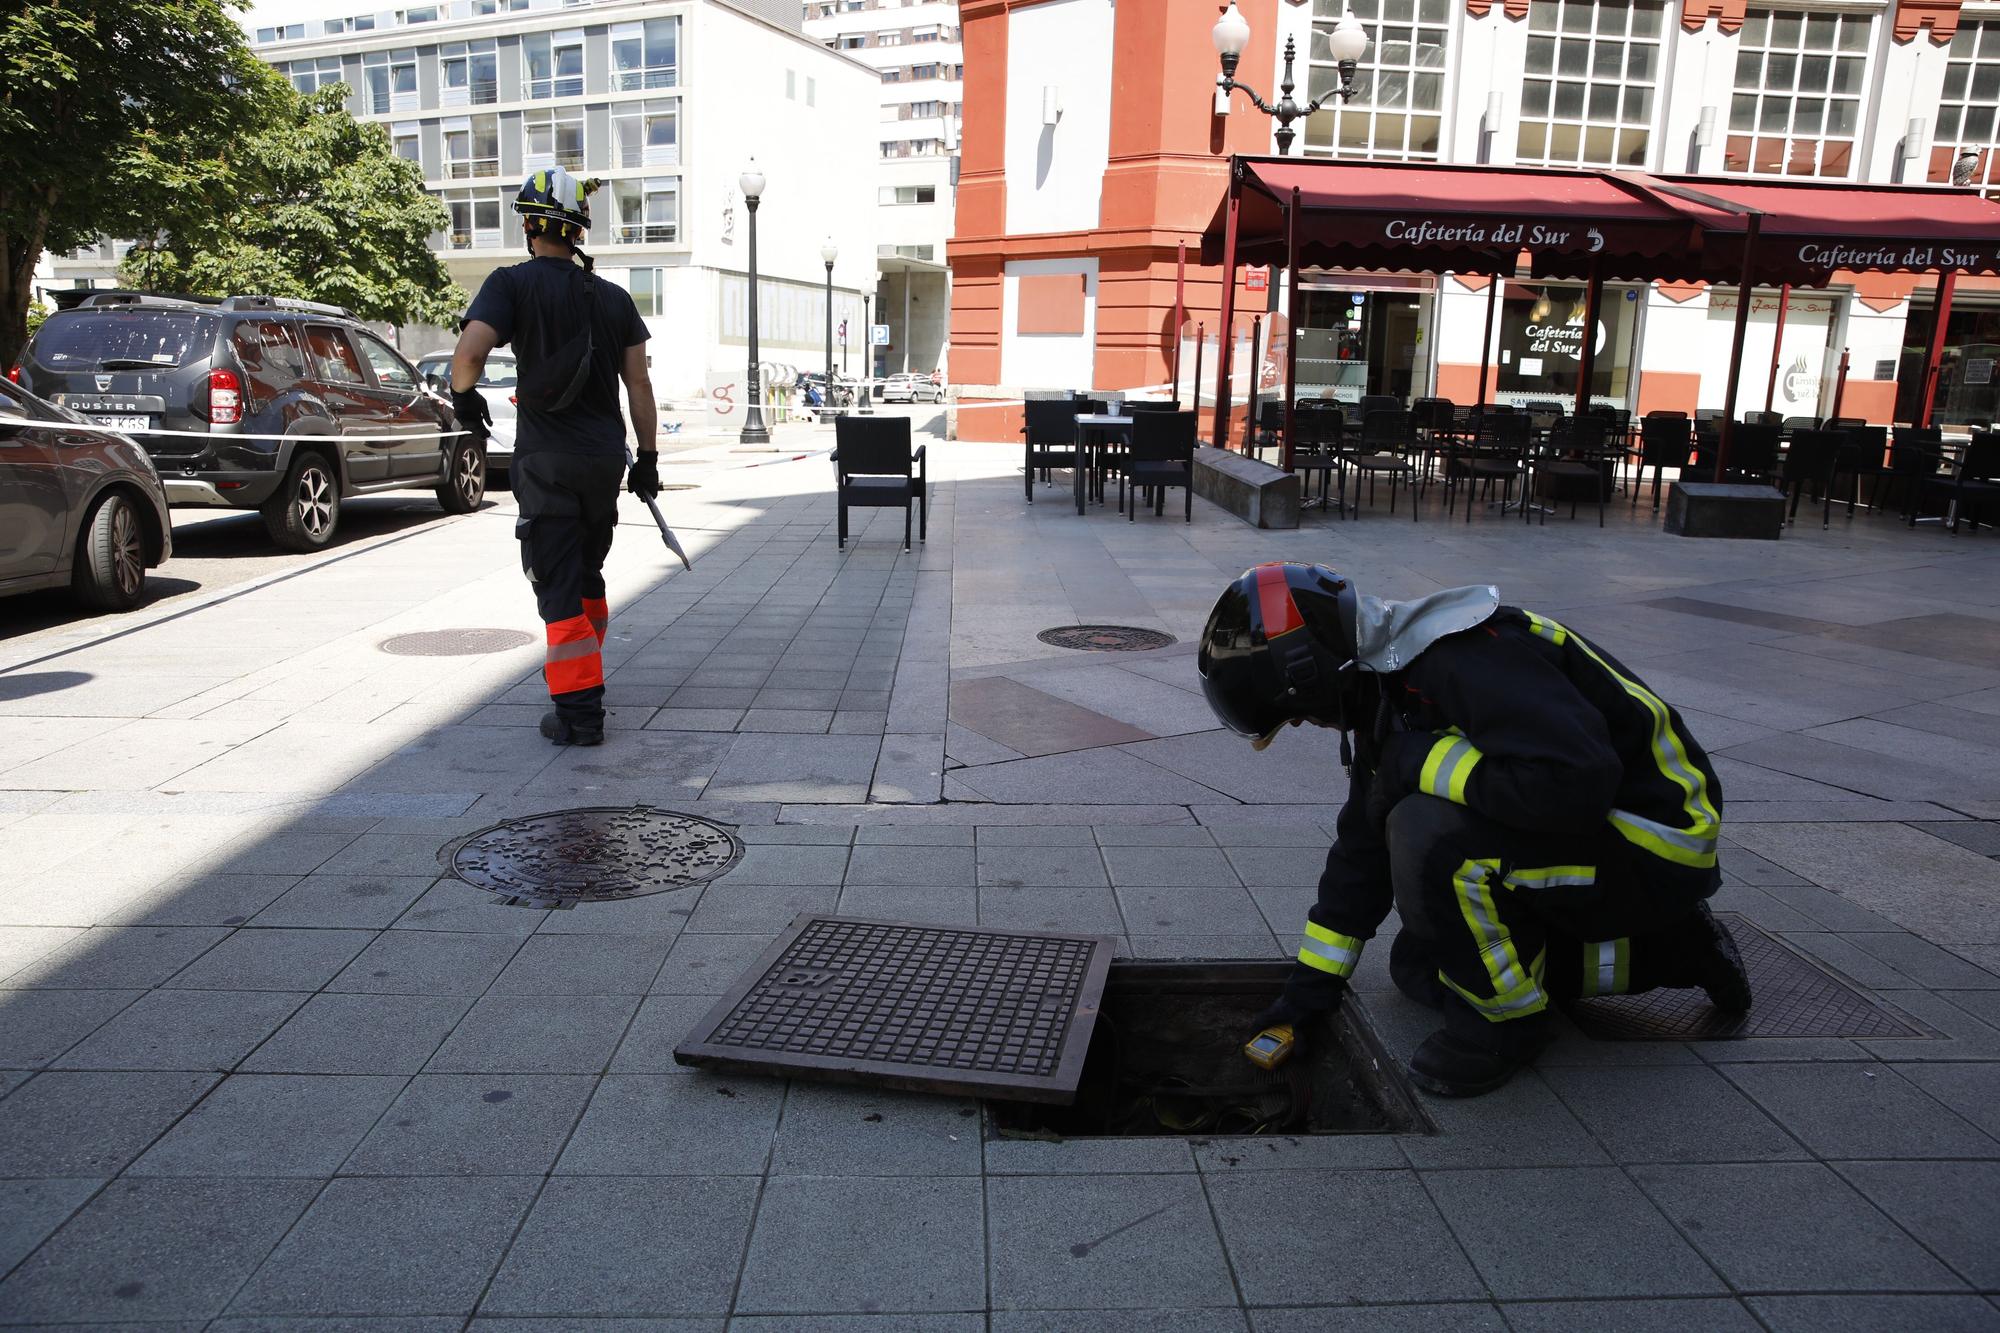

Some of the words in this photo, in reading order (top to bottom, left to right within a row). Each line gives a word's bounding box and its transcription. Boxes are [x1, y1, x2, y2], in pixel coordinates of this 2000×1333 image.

[1385, 220, 1485, 245] Cafetería
[1491, 223, 1524, 243] del
[1529, 225, 1570, 245] Sur
[1798, 244, 1896, 269] Cafetería
[1902, 247, 1933, 265] del
[1940, 248, 1980, 266] Sur
[872, 327, 886, 343] P
[1525, 325, 1583, 340] Cafetería
[1530, 340, 1549, 352] del
[1551, 341, 1577, 354] Sur
[71, 402, 136, 411] DUSTER
[118, 417, 145, 430] KGS
